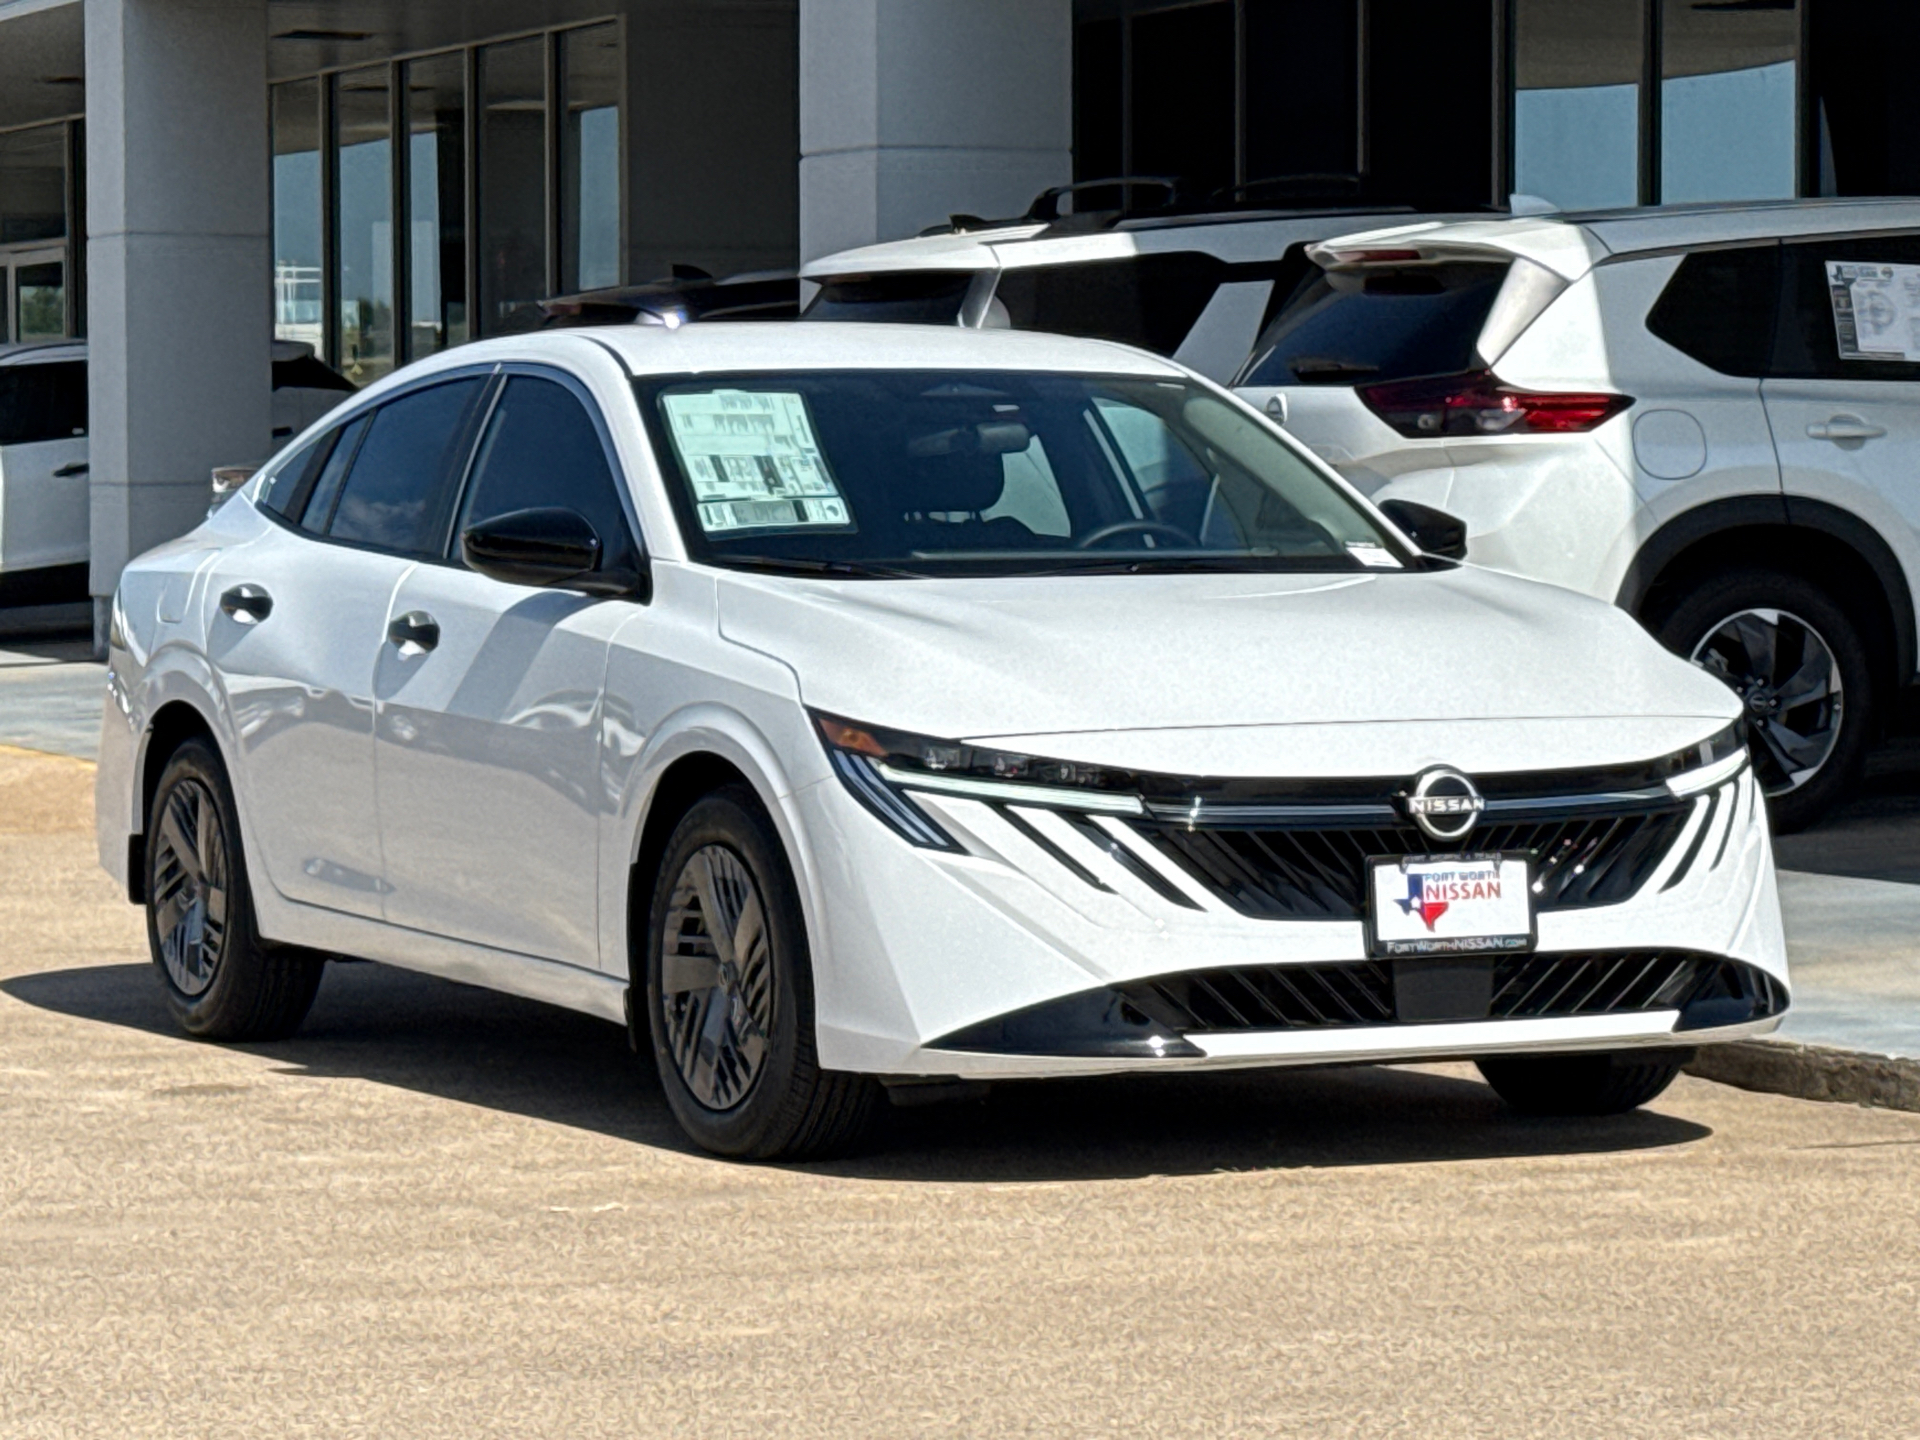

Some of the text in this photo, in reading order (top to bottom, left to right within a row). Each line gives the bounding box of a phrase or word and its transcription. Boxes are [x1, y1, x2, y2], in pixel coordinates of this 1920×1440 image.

[1409, 798, 1485, 814] NISSAN
[1425, 869, 1501, 882] FORT WORTH
[1425, 881, 1502, 900] NISSAN
